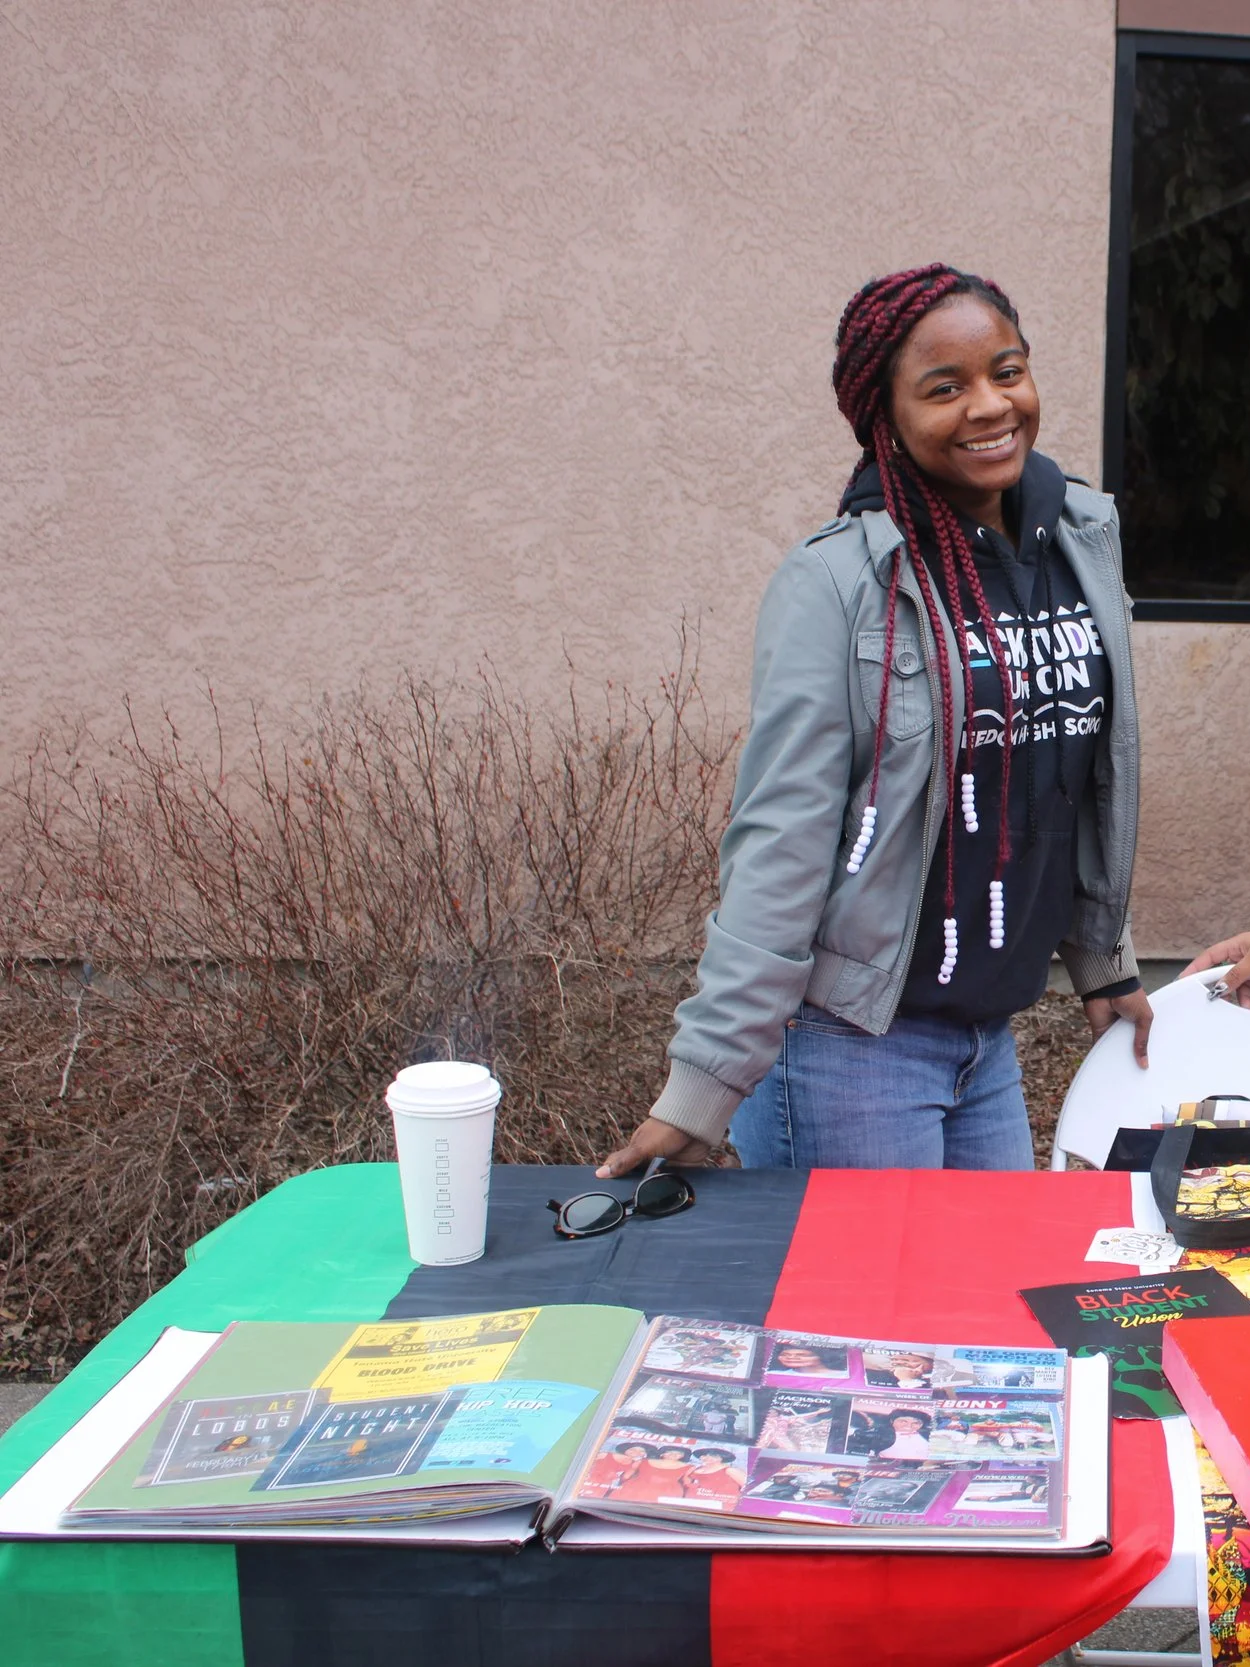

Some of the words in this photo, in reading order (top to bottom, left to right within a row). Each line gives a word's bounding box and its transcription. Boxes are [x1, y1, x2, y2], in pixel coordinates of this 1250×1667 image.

[1075, 1285, 1191, 1310] BLACK
[1079, 1295, 1209, 1321] STUDENT
[1112, 1312, 1183, 1328] Union
[389, 1342, 431, 1353] Save
[434, 1335, 479, 1349] Lives
[356, 1366, 417, 1378] BLOOD
[422, 1357, 479, 1373] DRIVE
[461, 1386, 563, 1401] FREE
[333, 1403, 430, 1422] STUDENT
[455, 1400, 496, 1412] HIP
[503, 1400, 553, 1410] HOP
[857, 1398, 910, 1409] MICHAEL
[936, 1400, 1004, 1409] EBONY
[192, 1415, 290, 1436] LOBOS
[320, 1417, 421, 1439] NIGHT
